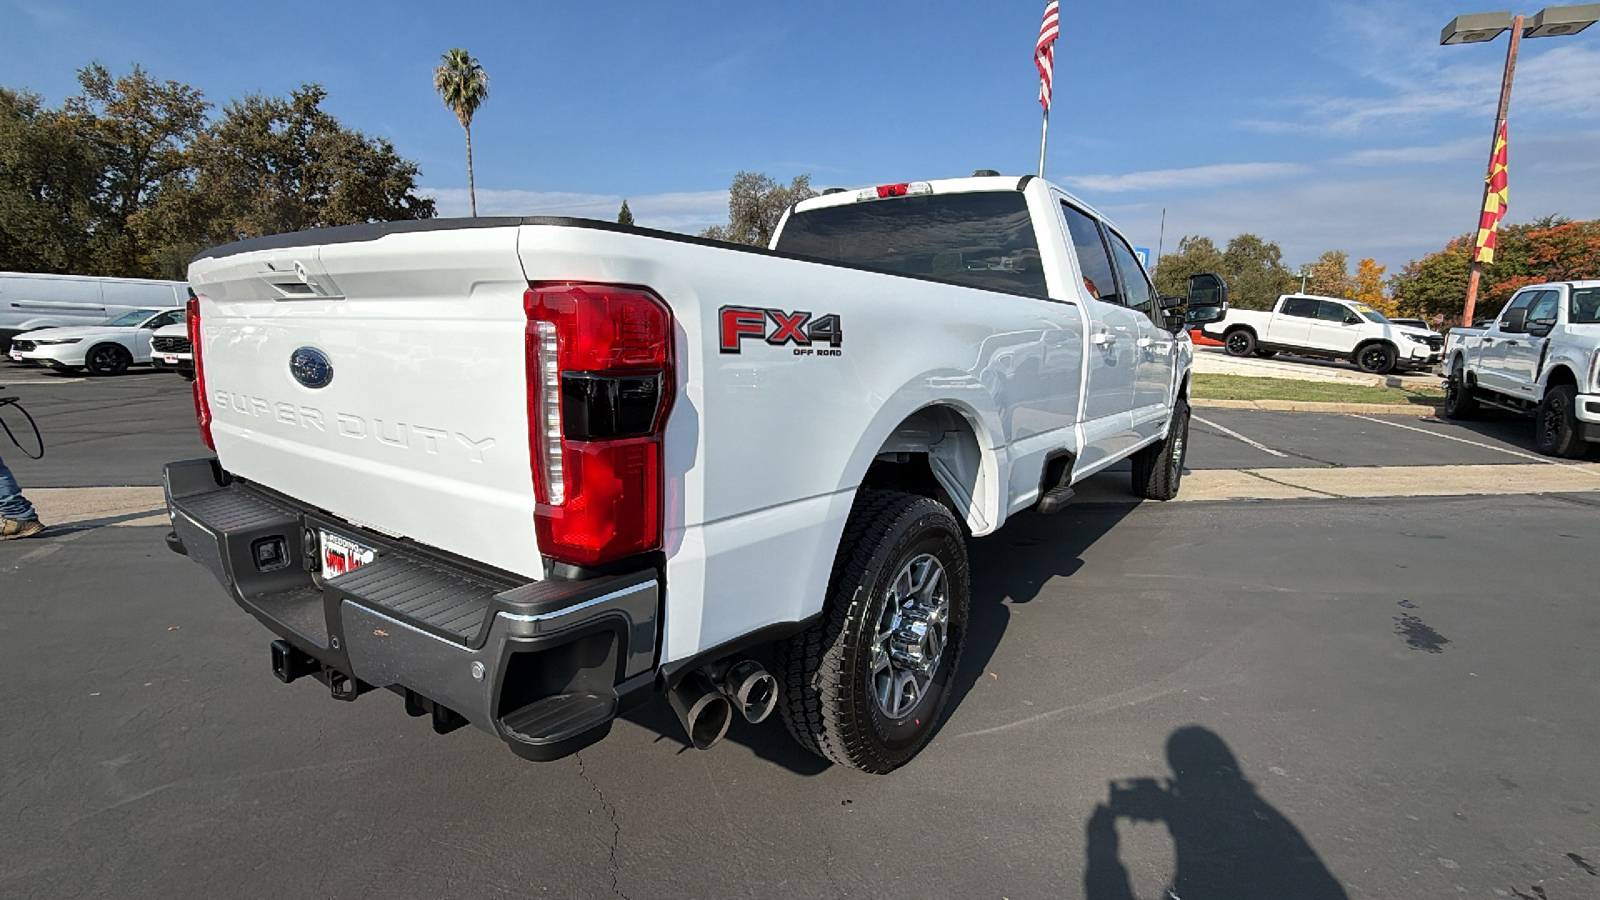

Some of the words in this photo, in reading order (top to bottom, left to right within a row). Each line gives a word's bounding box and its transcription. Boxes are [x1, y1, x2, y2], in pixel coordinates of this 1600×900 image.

[718, 304, 842, 354] FX4
[793, 348, 814, 356] OFF
[817, 349, 842, 357] ROAD
[214, 389, 326, 432] SUPER
[337, 412, 496, 464] DUTY
